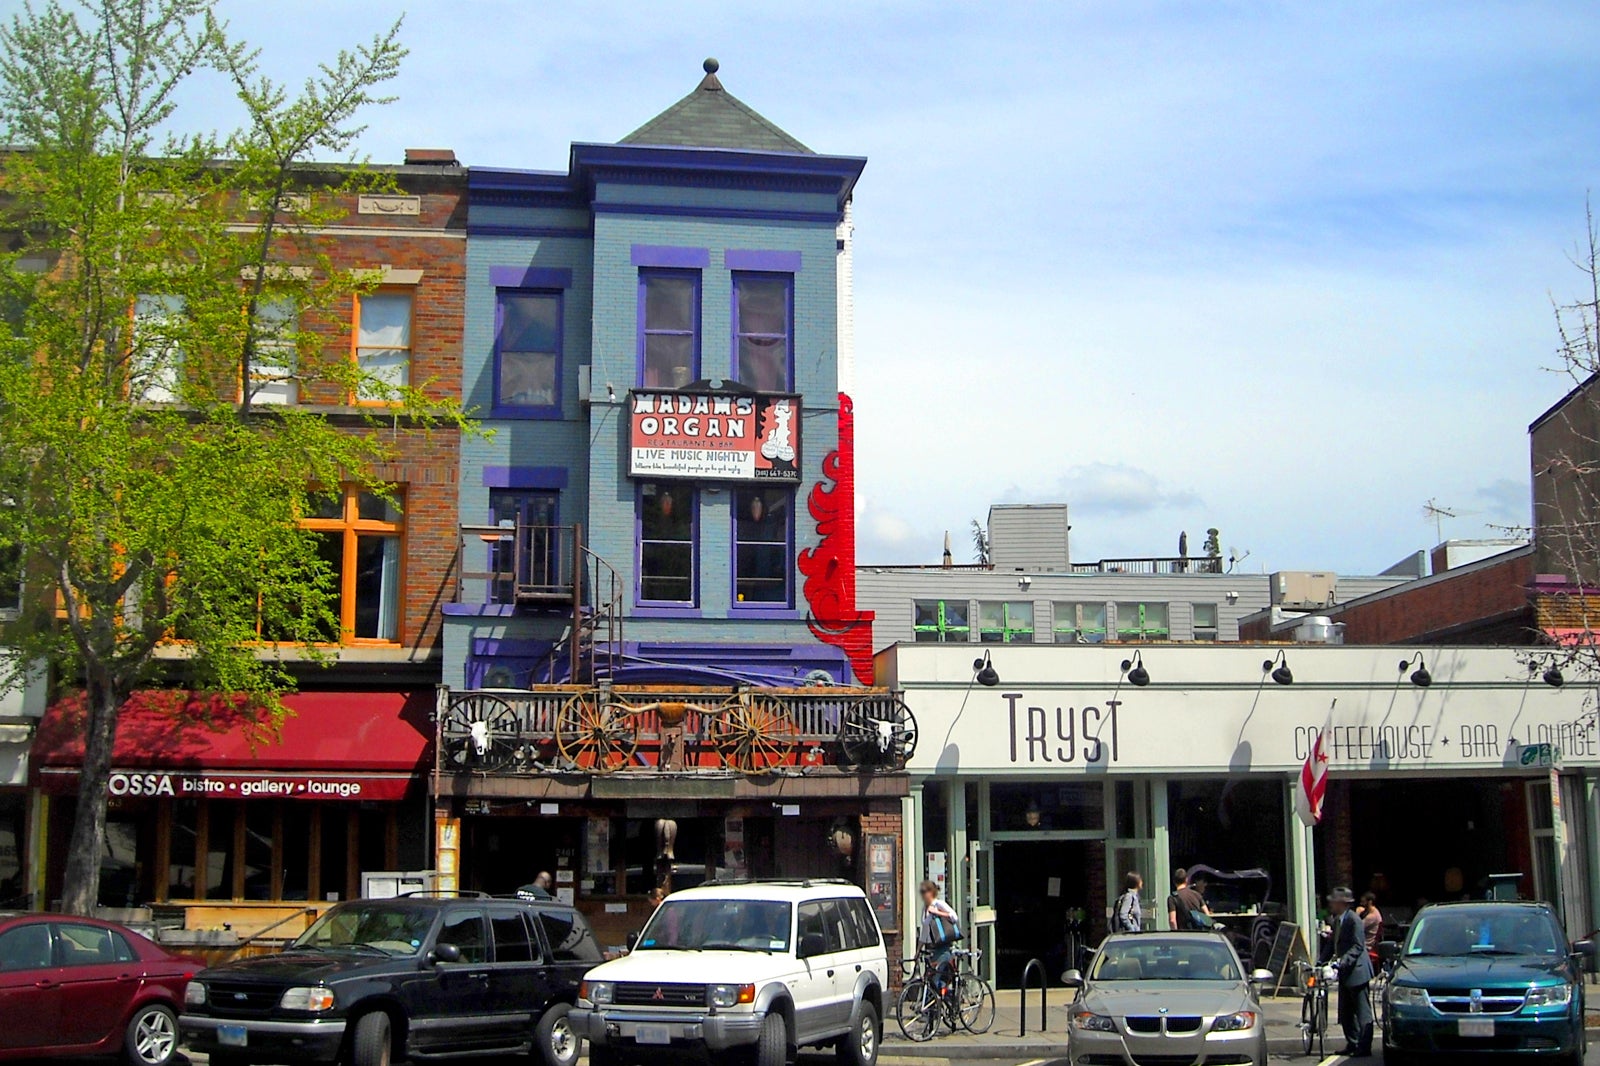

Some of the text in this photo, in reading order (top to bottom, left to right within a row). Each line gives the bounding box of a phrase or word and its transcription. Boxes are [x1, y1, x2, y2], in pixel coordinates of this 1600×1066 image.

[634, 394, 753, 415] MADAM'S
[640, 416, 745, 437] ORGAN
[648, 439, 706, 448] RESTAURANT
[637, 449, 749, 463] LIVE MUSIC NIGHTLY
[1294, 725, 1433, 761] COFEEHOUSE
[1459, 724, 1501, 758] BAR
[108, 774, 361, 797] OSSA bistro gallery lounge
